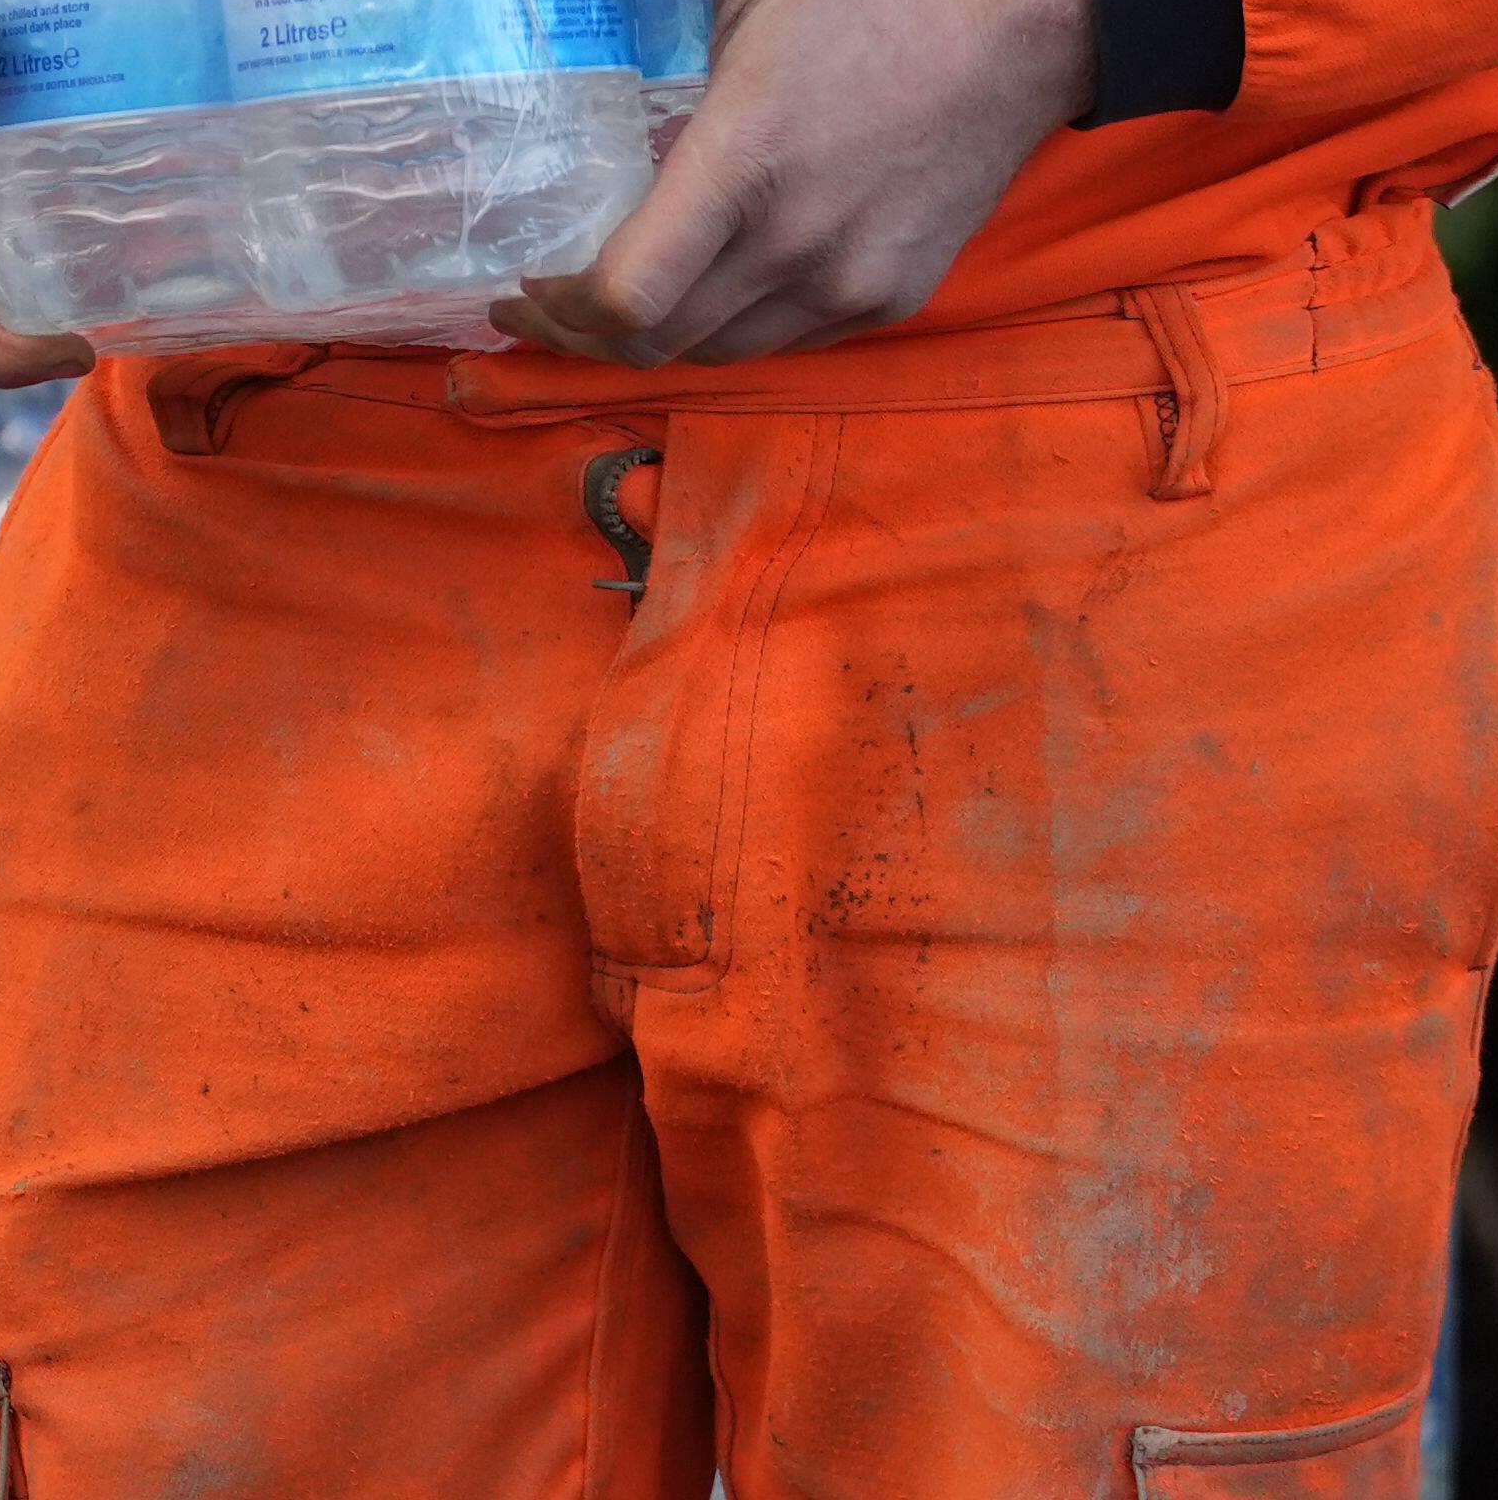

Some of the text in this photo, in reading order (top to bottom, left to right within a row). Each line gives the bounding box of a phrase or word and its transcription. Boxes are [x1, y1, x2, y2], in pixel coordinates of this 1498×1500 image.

[40, 3, 59, 17] and
[61, 1, 90, 14] store
[29, 19, 50, 35] dark
[53, 17, 82, 33] place
[260, 26, 271, 48] 2
